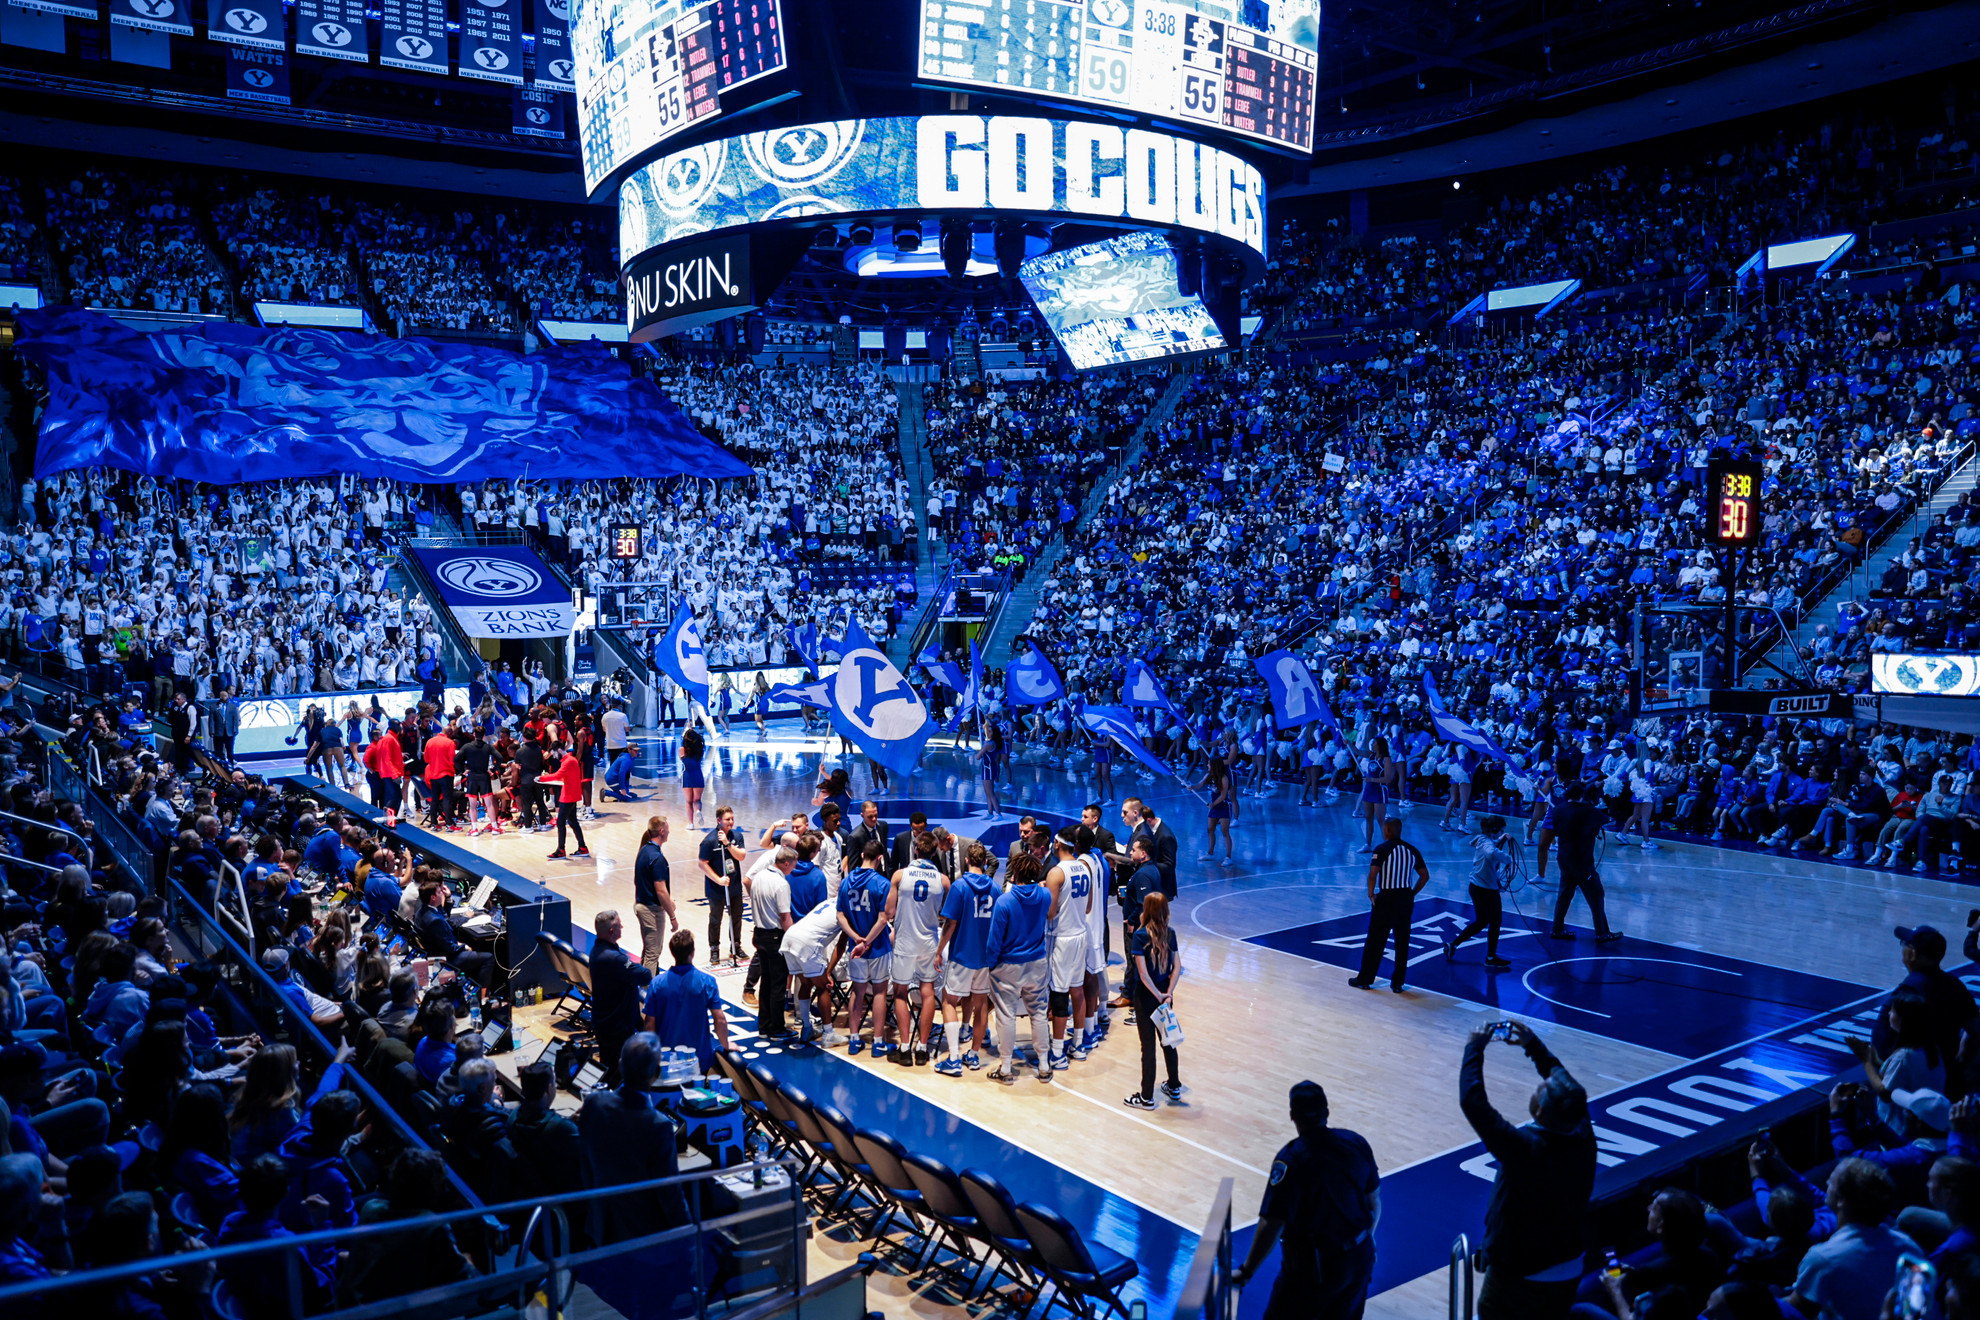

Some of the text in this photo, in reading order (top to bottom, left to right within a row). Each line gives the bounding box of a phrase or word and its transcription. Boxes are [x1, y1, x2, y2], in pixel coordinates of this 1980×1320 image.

[10, 0, 96, 19] MEN'S BASKETBALL
[717, 2, 723, 15] 2
[112, 17, 192, 35] MEN'S BASKETBALL
[232, 11, 260, 31] Y
[1050, 22, 1058, 37] 2
[1145, 9, 1175, 36] 3:38
[319, 25, 345, 44] Y
[492, 32, 510, 42] 2011
[543, 27, 562, 36] 1950
[689, 47, 707, 66] BUTLER
[719, 20, 724, 32] 9
[735, 12, 741, 25] 0
[752, 4, 757, 18] 3
[721, 37, 727, 50] 5
[738, 30, 742, 43] 1
[754, 23, 760, 36] 0
[770, 16, 776, 29] 0
[210, 34, 234, 42] MEN'S
[236, 38, 284, 50] BASKETBALL
[402, 38, 427, 56] Y
[543, 38, 560, 46] 1951
[722, 54, 730, 68] 17
[756, 41, 762, 54] 1
[772, 34, 777, 47] 1
[1001, 32, 1009, 47] 7
[1069, 44, 1078, 59] 2
[232, 48, 283, 66] WATTS
[297, 47, 367, 62] MEN'S BASKETBALL
[480, 50, 502, 67] Y
[382, 59, 447, 74] MEN'S BASKETBALL
[1024, 54, 1033, 70] 2
[1068, 62, 1077, 77] 2
[1088, 55, 1127, 94] 59
[1227, 46, 1232, 58] 4
[1238, 49, 1248, 63] PAL
[1271, 60, 1276, 72] 2
[1285, 65, 1290, 77] 2
[1308, 74, 1313, 85] 2
[482, 73, 523, 84] BASKETBALL
[695, 98, 716, 118] WATERS
[759, 58, 763, 71] 1
[774, 52, 779, 65] 1
[1226, 62, 1231, 75] 5
[1237, 66, 1256, 82] BUTLER
[1270, 76, 1275, 88] 9
[1284, 80, 1289, 92] 0
[229, 90, 289, 103] MEN'S BASKETBALL
[521, 90, 554, 103] COSIC
[1184, 75, 1216, 113] 55
[1225, 79, 1233, 92] 12
[1236, 82, 1262, 101] TRAMMELL
[1269, 92, 1275, 104] 5
[1295, 101, 1300, 112] 0
[1306, 104, 1311, 116] 0
[658, 86, 680, 127] 55
[1224, 96, 1231, 109] 13
[1235, 99, 1250, 113] LEDEE
[1267, 108, 1275, 120] 17
[1223, 113, 1231, 125] 14
[1234, 115, 1255, 131] WATERS
[532, 130, 563, 138] BASKETBALL
[782, 128, 819, 162] Y
[917, 115, 1263, 253] GO COUGS
[636, 270, 660, 319] NU
[1727, 474, 1751, 497] 3:38
[1722, 498, 1748, 538] 30
[620, 529, 638, 538] 3:38
[617, 539, 635, 555] 30
[480, 581, 509, 590] Y
[478, 609, 560, 621] ZIONS
[488, 620, 569, 633] BANK
[1905, 660, 1953, 691] Y
[1776, 697, 1828, 713] BUILT
[909, 871, 936, 879] WATERMAN
[913, 880, 928, 902] 0
[1071, 874, 1089, 898] 50
[848, 889, 870, 912] 24
[974, 895, 993, 918] 12
